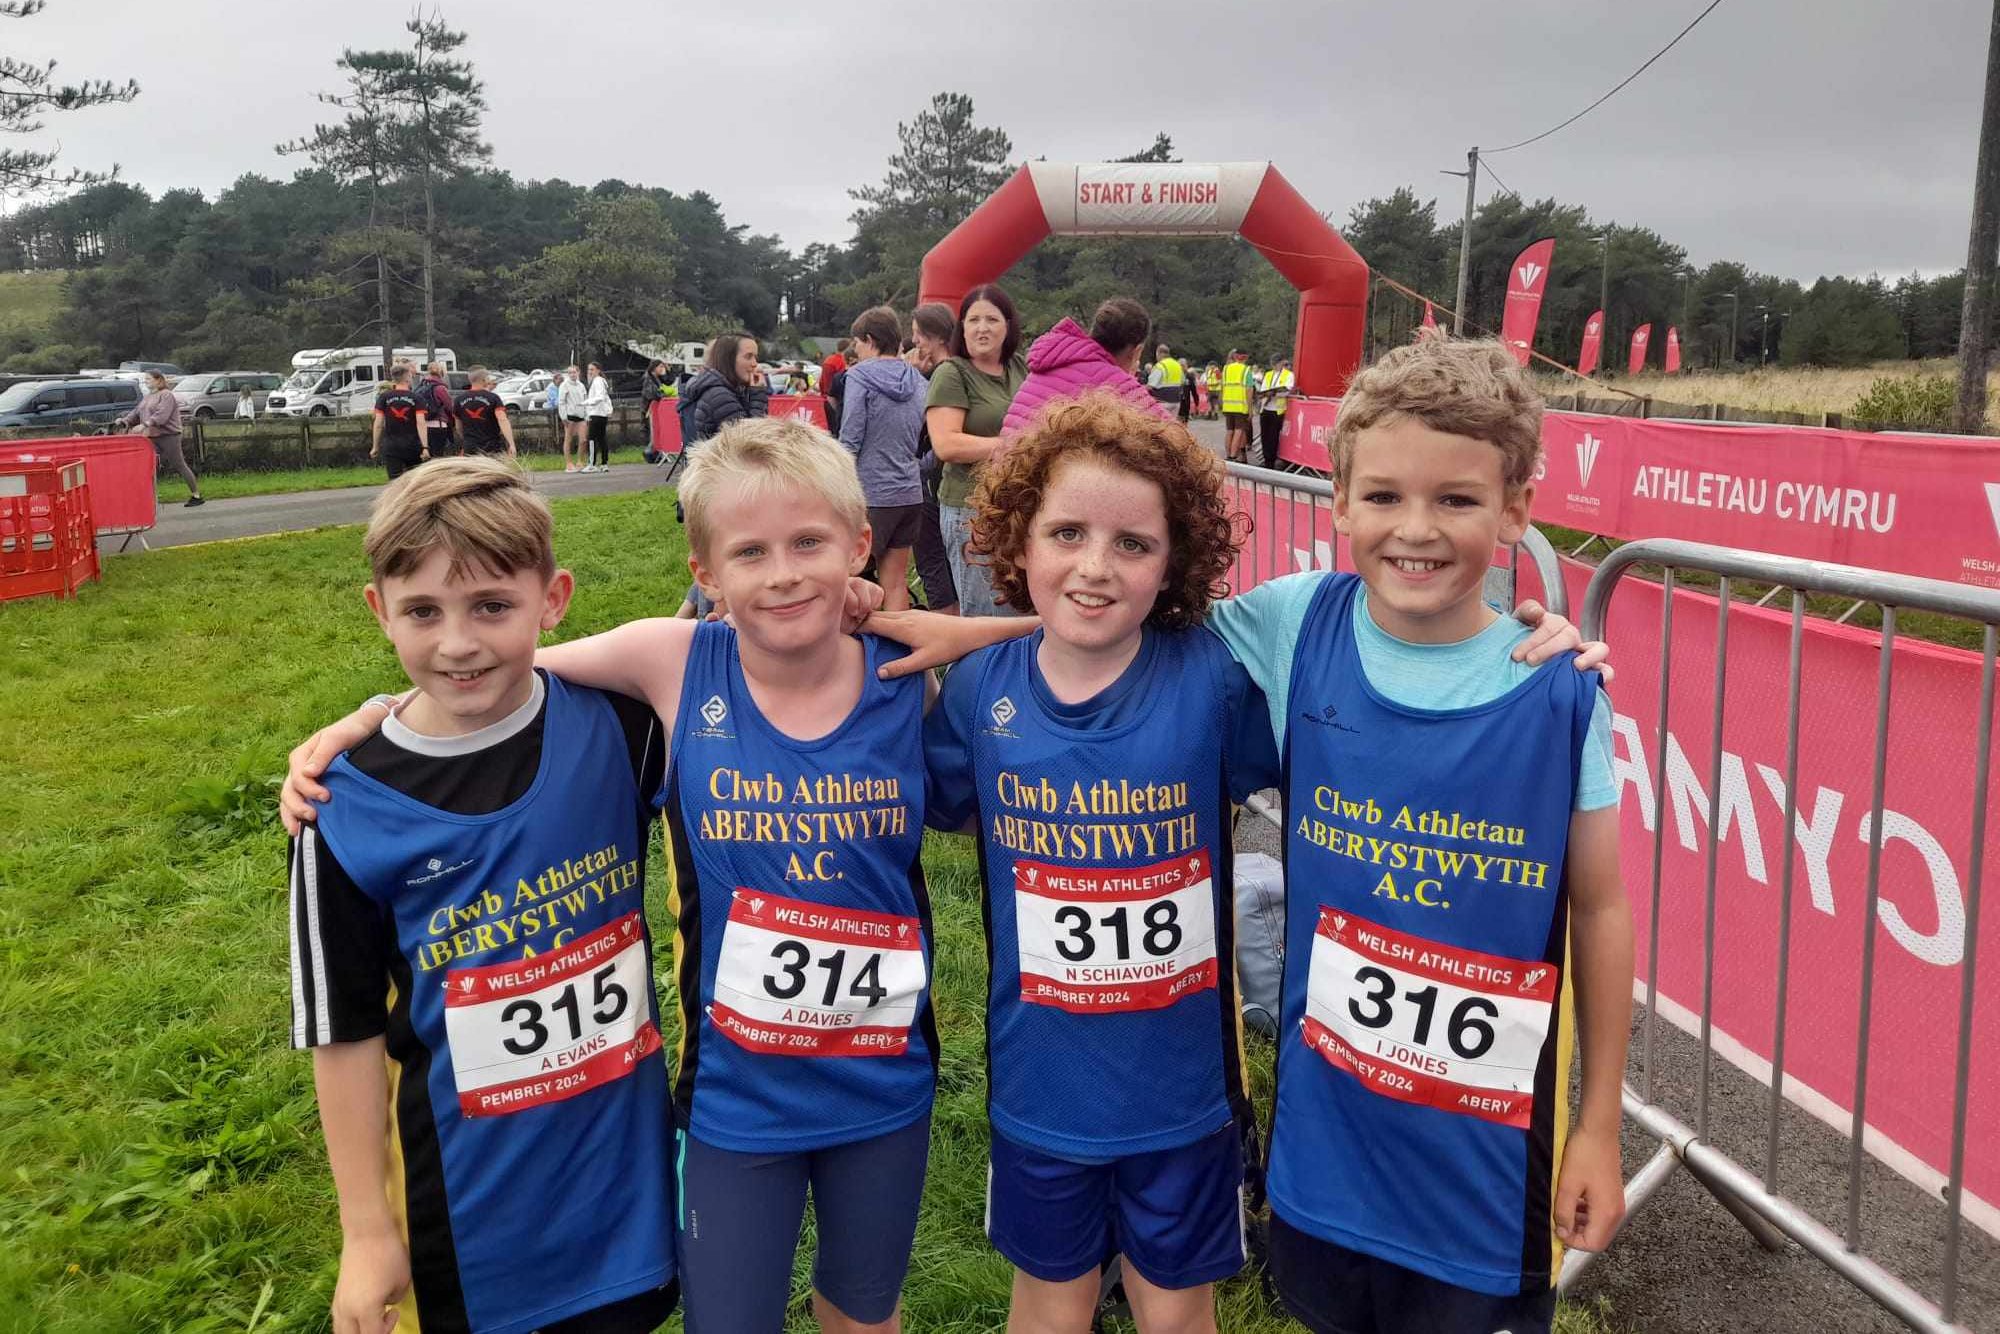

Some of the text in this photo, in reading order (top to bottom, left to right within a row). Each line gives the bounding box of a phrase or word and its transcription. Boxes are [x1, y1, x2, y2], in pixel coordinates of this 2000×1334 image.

[1080, 182, 1218, 204] START & FINISH
[1633, 465, 1767, 515] ATHLETAU
[1775, 481, 1896, 534] CYMRU
[1961, 557, 1995, 572] WELSH
[709, 767, 899, 805] Clwb Athletau
[997, 772, 1189, 815] Clwb Athletau
[700, 805, 906, 844] ABERYSTWYTH
[1314, 785, 1525, 846] Clwb Athletau
[992, 811, 1197, 861] ABERYSTWYTH
[1296, 814, 1549, 889] ABERYSTWYTH
[784, 851, 843, 882] A.C.
[1046, 869, 1181, 892] WELSH ATHLETICS
[428, 843, 618, 935] Clwb Athletau
[1371, 871, 1450, 910] A.C.
[775, 907, 828, 930] WELSH
[830, 919, 891, 938] ATHLETICS
[1054, 900, 1182, 962] 318
[487, 932, 617, 992] WELSH ATHLETICS
[763, 939, 887, 1008] 314
[1066, 960, 1176, 982] N SCHIAVONE
[1356, 928, 1513, 984] WELSH ATHLETICS
[1038, 983, 1130, 1004] PEMBREY 2024
[1168, 970, 1202, 996] ABERY
[501, 963, 628, 1056] 315
[781, 1008, 853, 1026] A DAVIES
[1348, 965, 1499, 1060] 316
[726, 1017, 818, 1047] PEMBREY 2024
[851, 1033, 894, 1047] ABERY
[540, 1057, 552, 1071] A
[557, 1034, 608, 1067] EVANS
[1318, 1033, 1413, 1092] PEMBREY 2024
[1376, 1040, 1448, 1075] I JONES
[481, 1071, 587, 1108] PEMBREY 2024
[1458, 1094, 1512, 1113] ABERY
